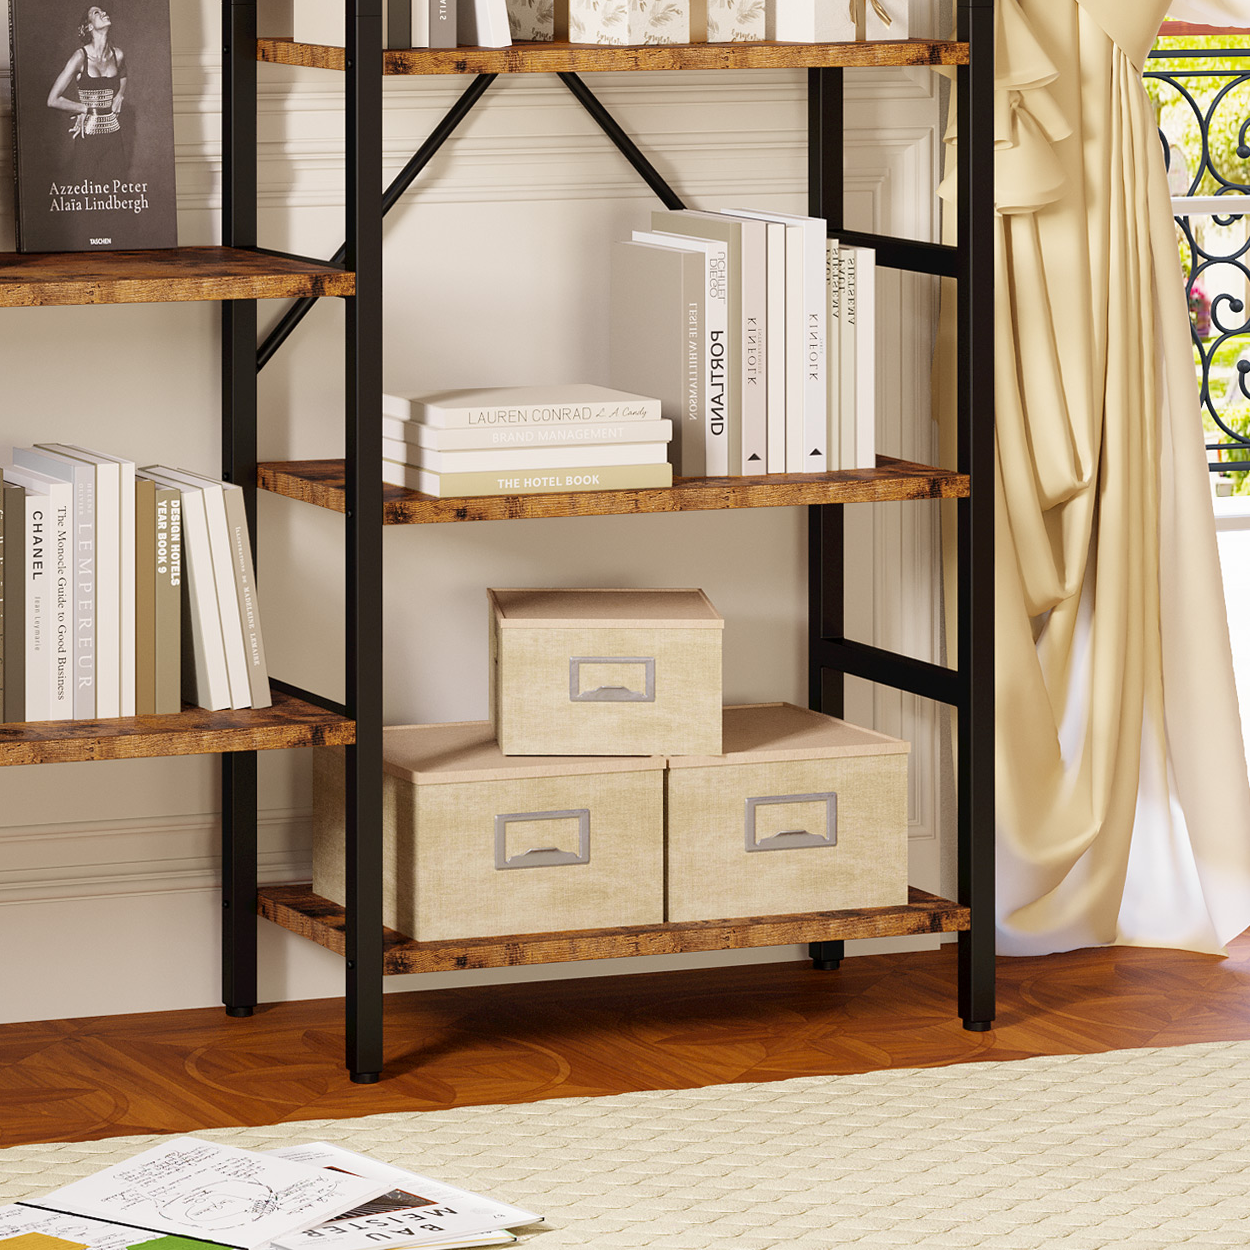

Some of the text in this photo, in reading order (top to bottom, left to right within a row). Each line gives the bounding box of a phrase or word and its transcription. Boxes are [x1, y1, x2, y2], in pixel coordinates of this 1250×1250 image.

[50, 180, 148, 195] Azzedine Peter
[85, 195, 149, 213] Lindbergh
[468, 410, 527, 425] LAUREN
[532, 407, 592, 423] CONRAD
[492, 428, 624, 443] BRAND MANAGEMENT
[498, 475, 600, 489] THE HOTEL BOOK
[158, 500, 167, 530] YEAR
[32, 511, 43, 580] CHANEL
[158, 534, 167, 564] BOOK
[171, 500, 180, 586] DESIGN HOTELS
[57, 506, 68, 700] The Monocle Guide to Good Business
[78, 523, 93, 689] LEMPEREUR
